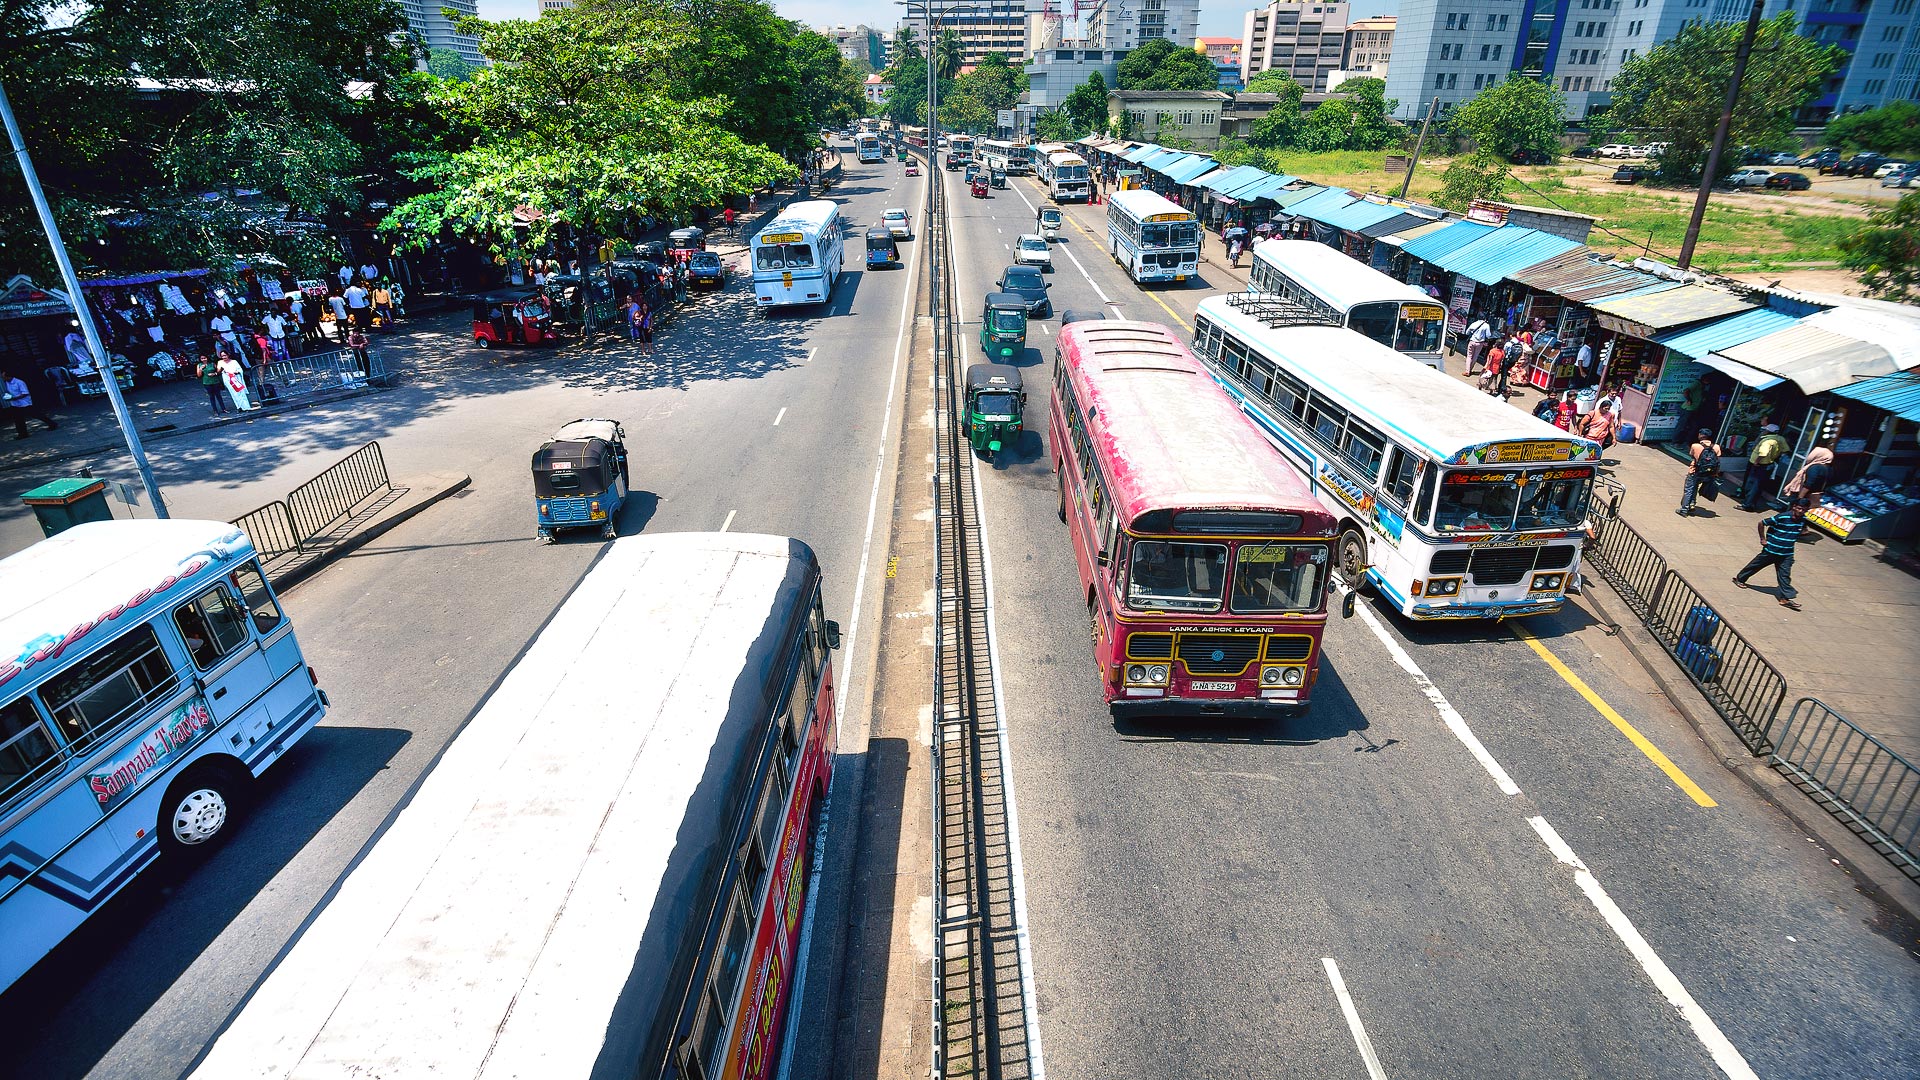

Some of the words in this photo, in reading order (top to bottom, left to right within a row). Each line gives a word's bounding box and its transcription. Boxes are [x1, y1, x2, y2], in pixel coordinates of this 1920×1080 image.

[27, 300, 65, 308] Reservation
[1216, 683, 1236, 691] 5217
[91, 741, 158, 803] Sampath
[155, 704, 209, 754] Travels
